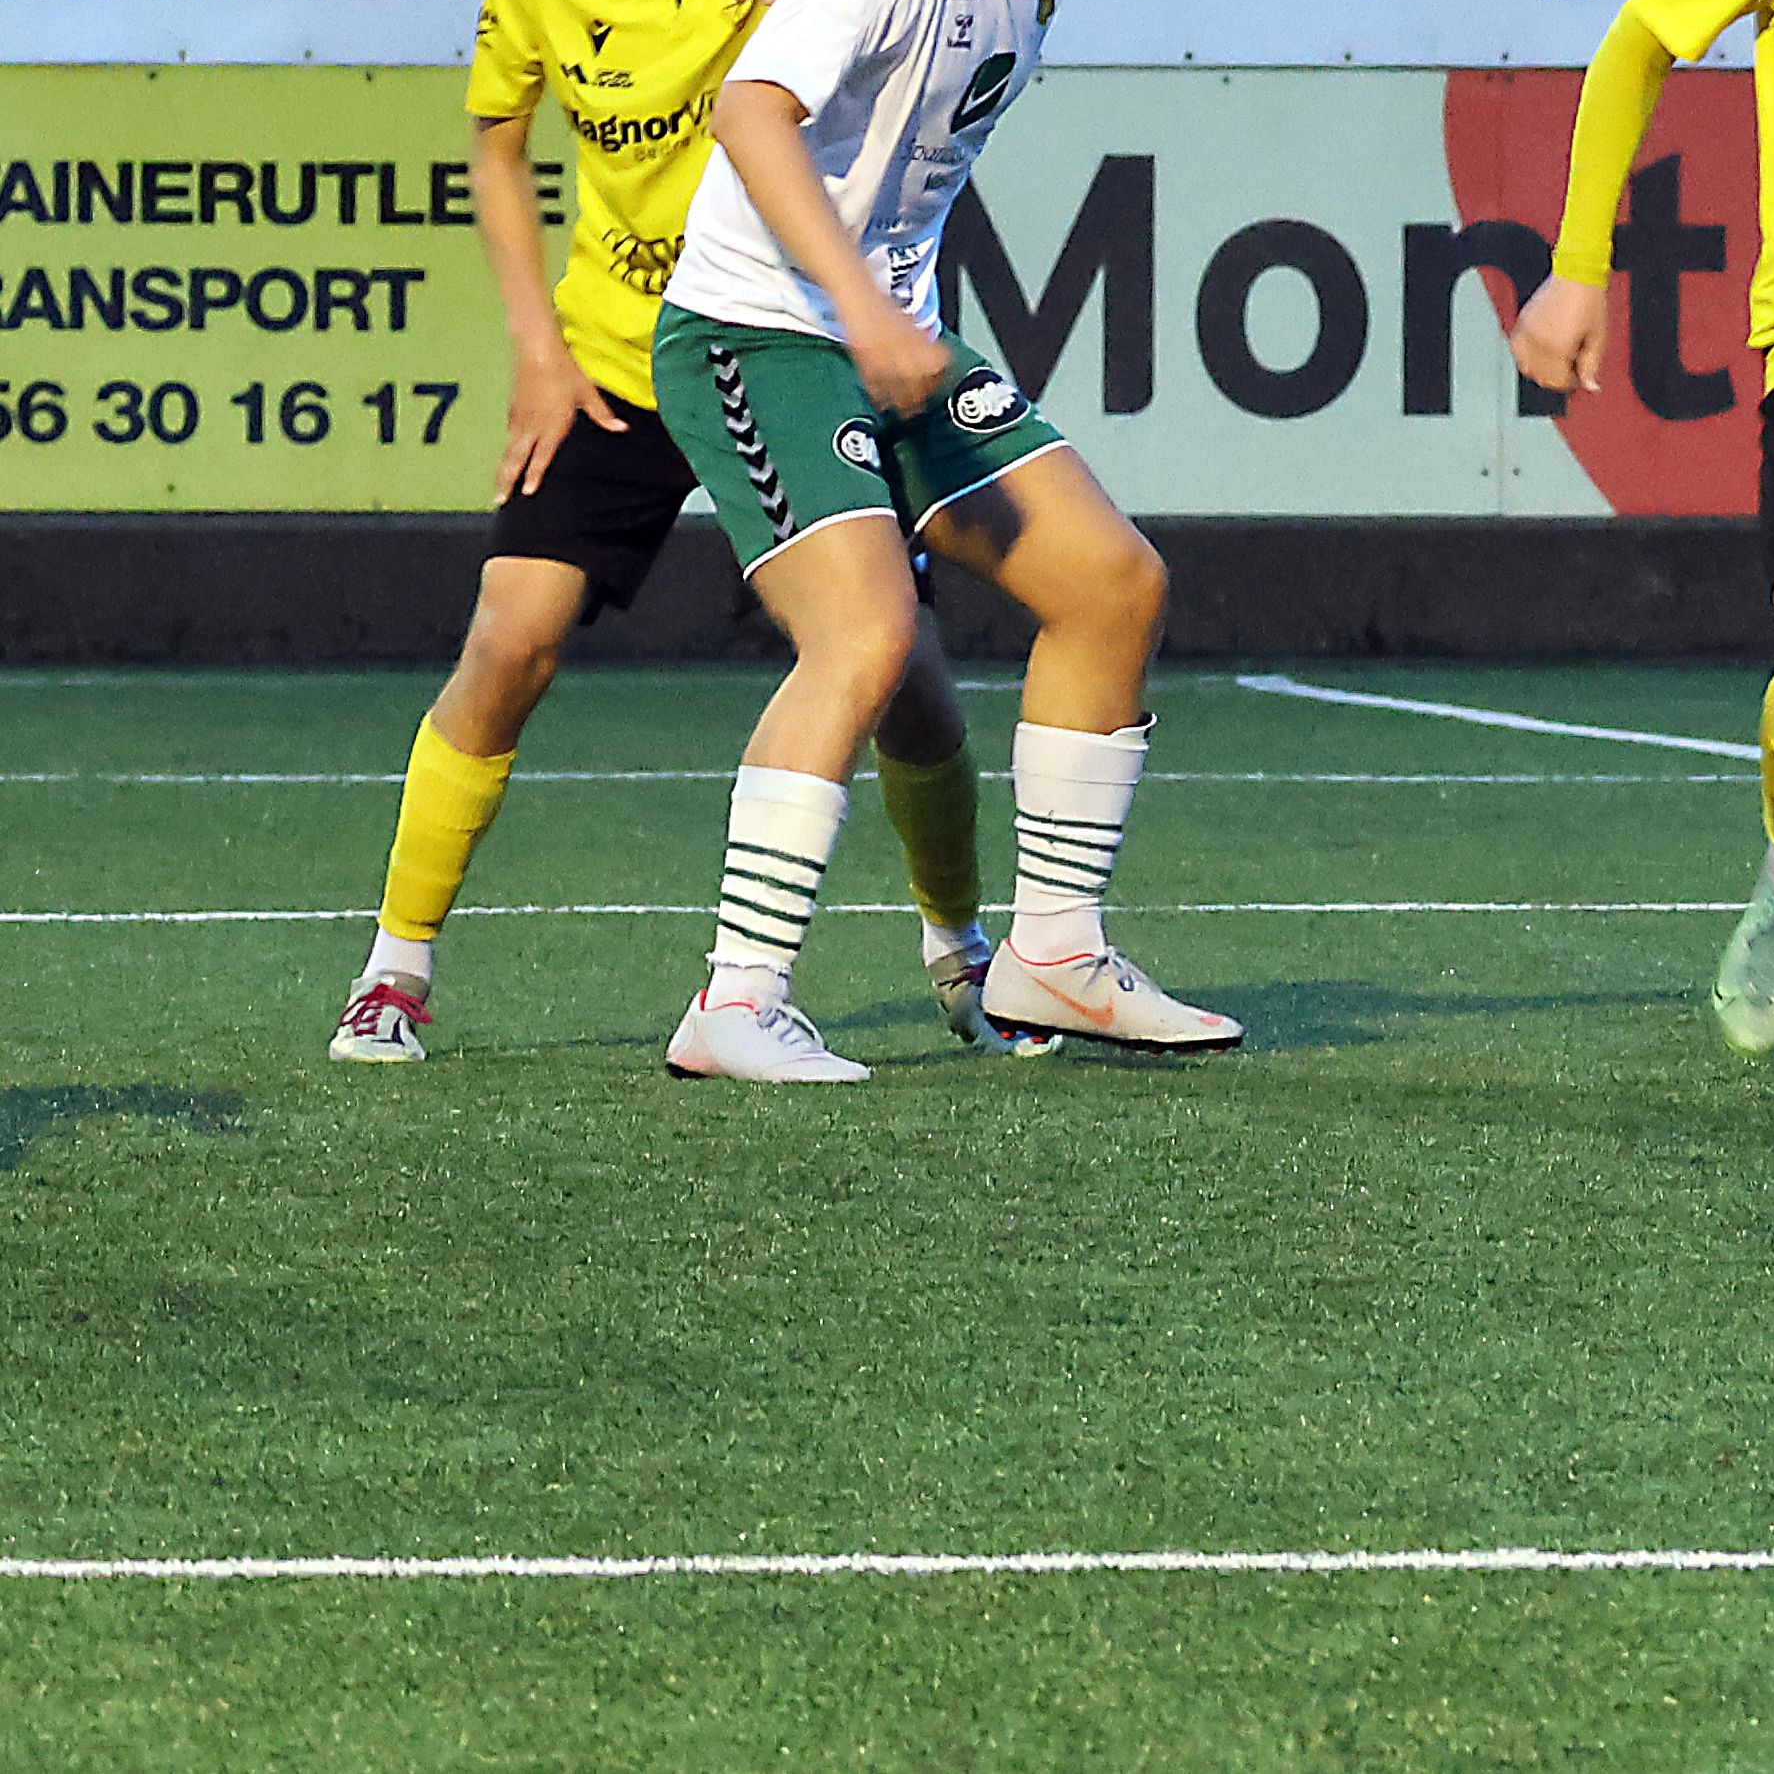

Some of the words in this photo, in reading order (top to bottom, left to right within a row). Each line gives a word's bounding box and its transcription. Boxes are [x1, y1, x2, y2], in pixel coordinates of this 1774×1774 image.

[0, 160, 566, 225] AINERUTLEE
[0, 267, 426, 332] ANSPORT
[0, 380, 68, 444] 6
[93, 380, 200, 444] 30
[231, 380, 332, 444] 16
[363, 380, 460, 444] 17
